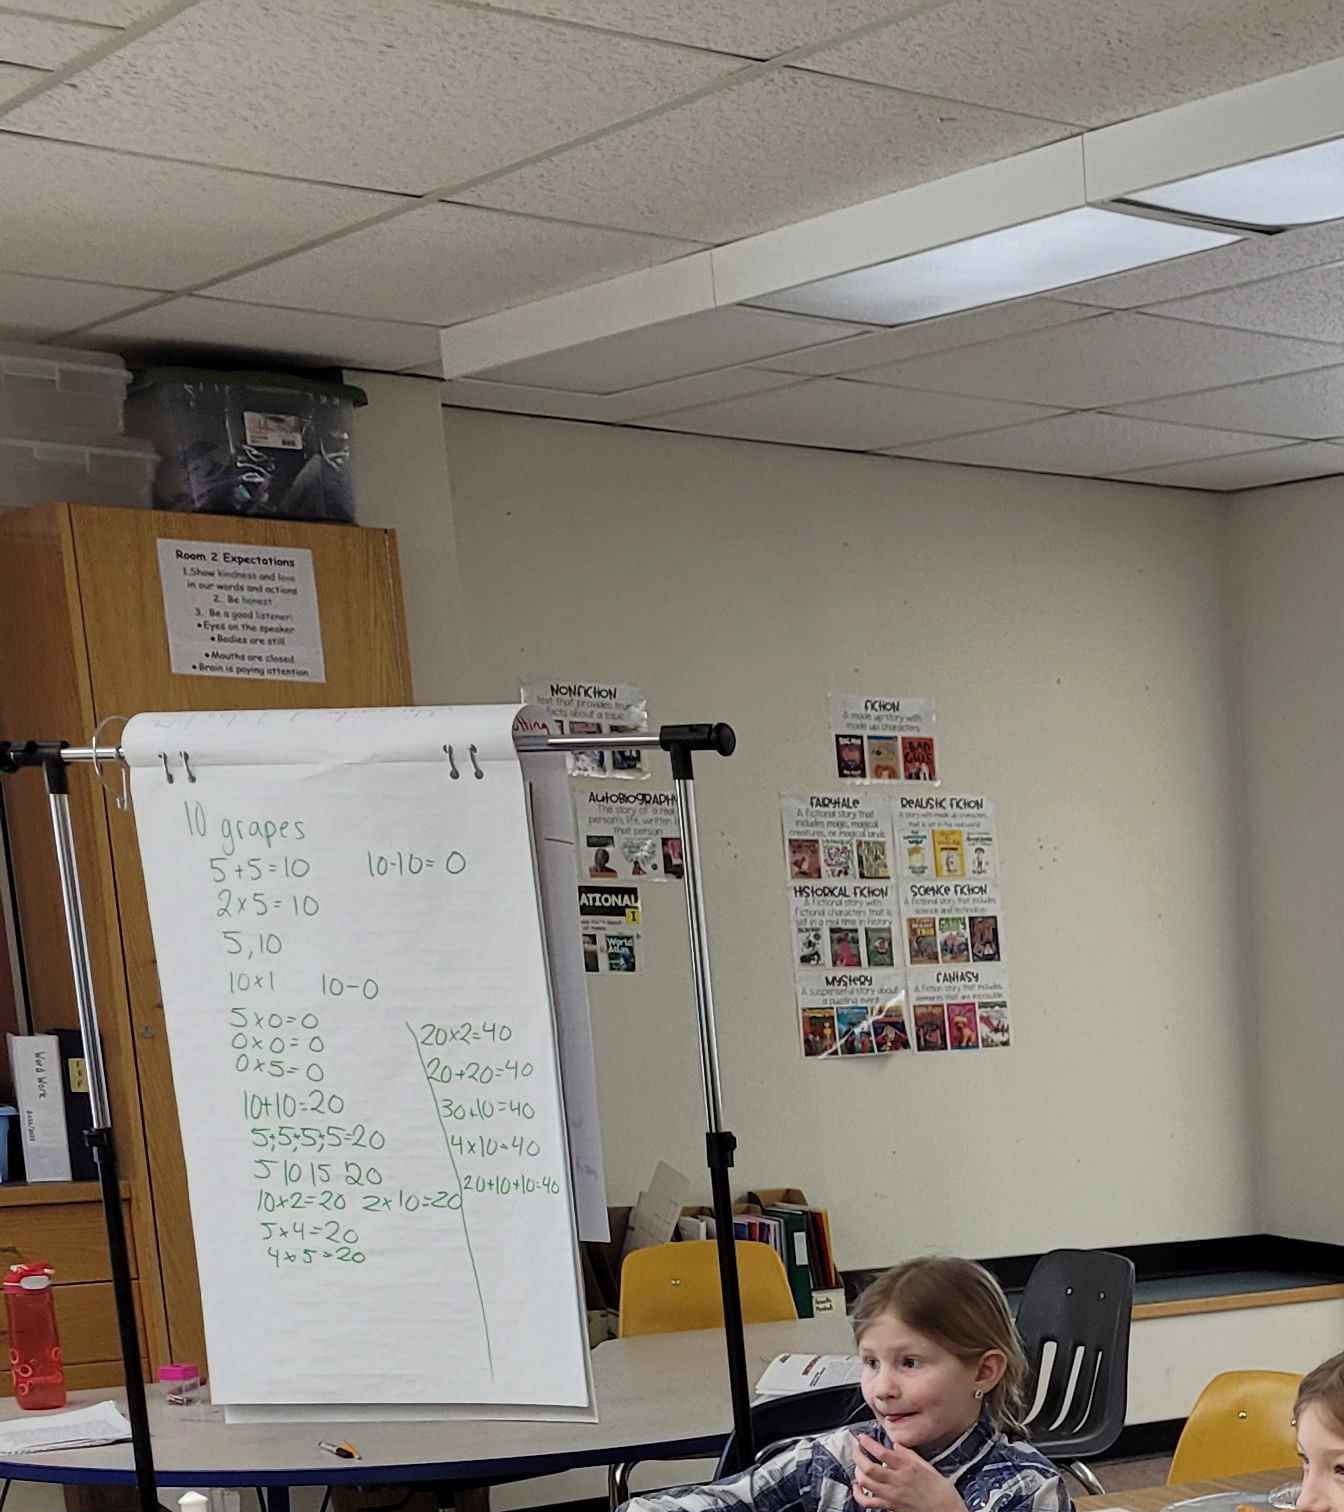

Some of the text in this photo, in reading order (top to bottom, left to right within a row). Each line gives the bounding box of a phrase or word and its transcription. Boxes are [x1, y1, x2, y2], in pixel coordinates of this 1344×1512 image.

[176, 549, 295, 567] Room 2 Expectations
[218, 569, 257, 580] kindness
[260, 571, 275, 581] and
[278, 572, 296, 582] love
[187, 581, 297, 595] in our words and actions
[227, 595, 240, 604] Be
[242, 596, 272, 606] honest
[209, 608, 222, 617] Be
[232, 610, 253, 621] good
[203, 622, 225, 632] Eyes
[241, 623, 257, 632] the
[260, 625, 295, 634] speaker
[217, 634, 247, 644] Bodies
[267, 636, 285, 645] still
[211, 651, 295, 663] Mouths are closed
[198, 663, 309, 676] Brain is paying attention
[184, 800, 306, 856] 10 grapes
[607, 937, 633, 946] World
